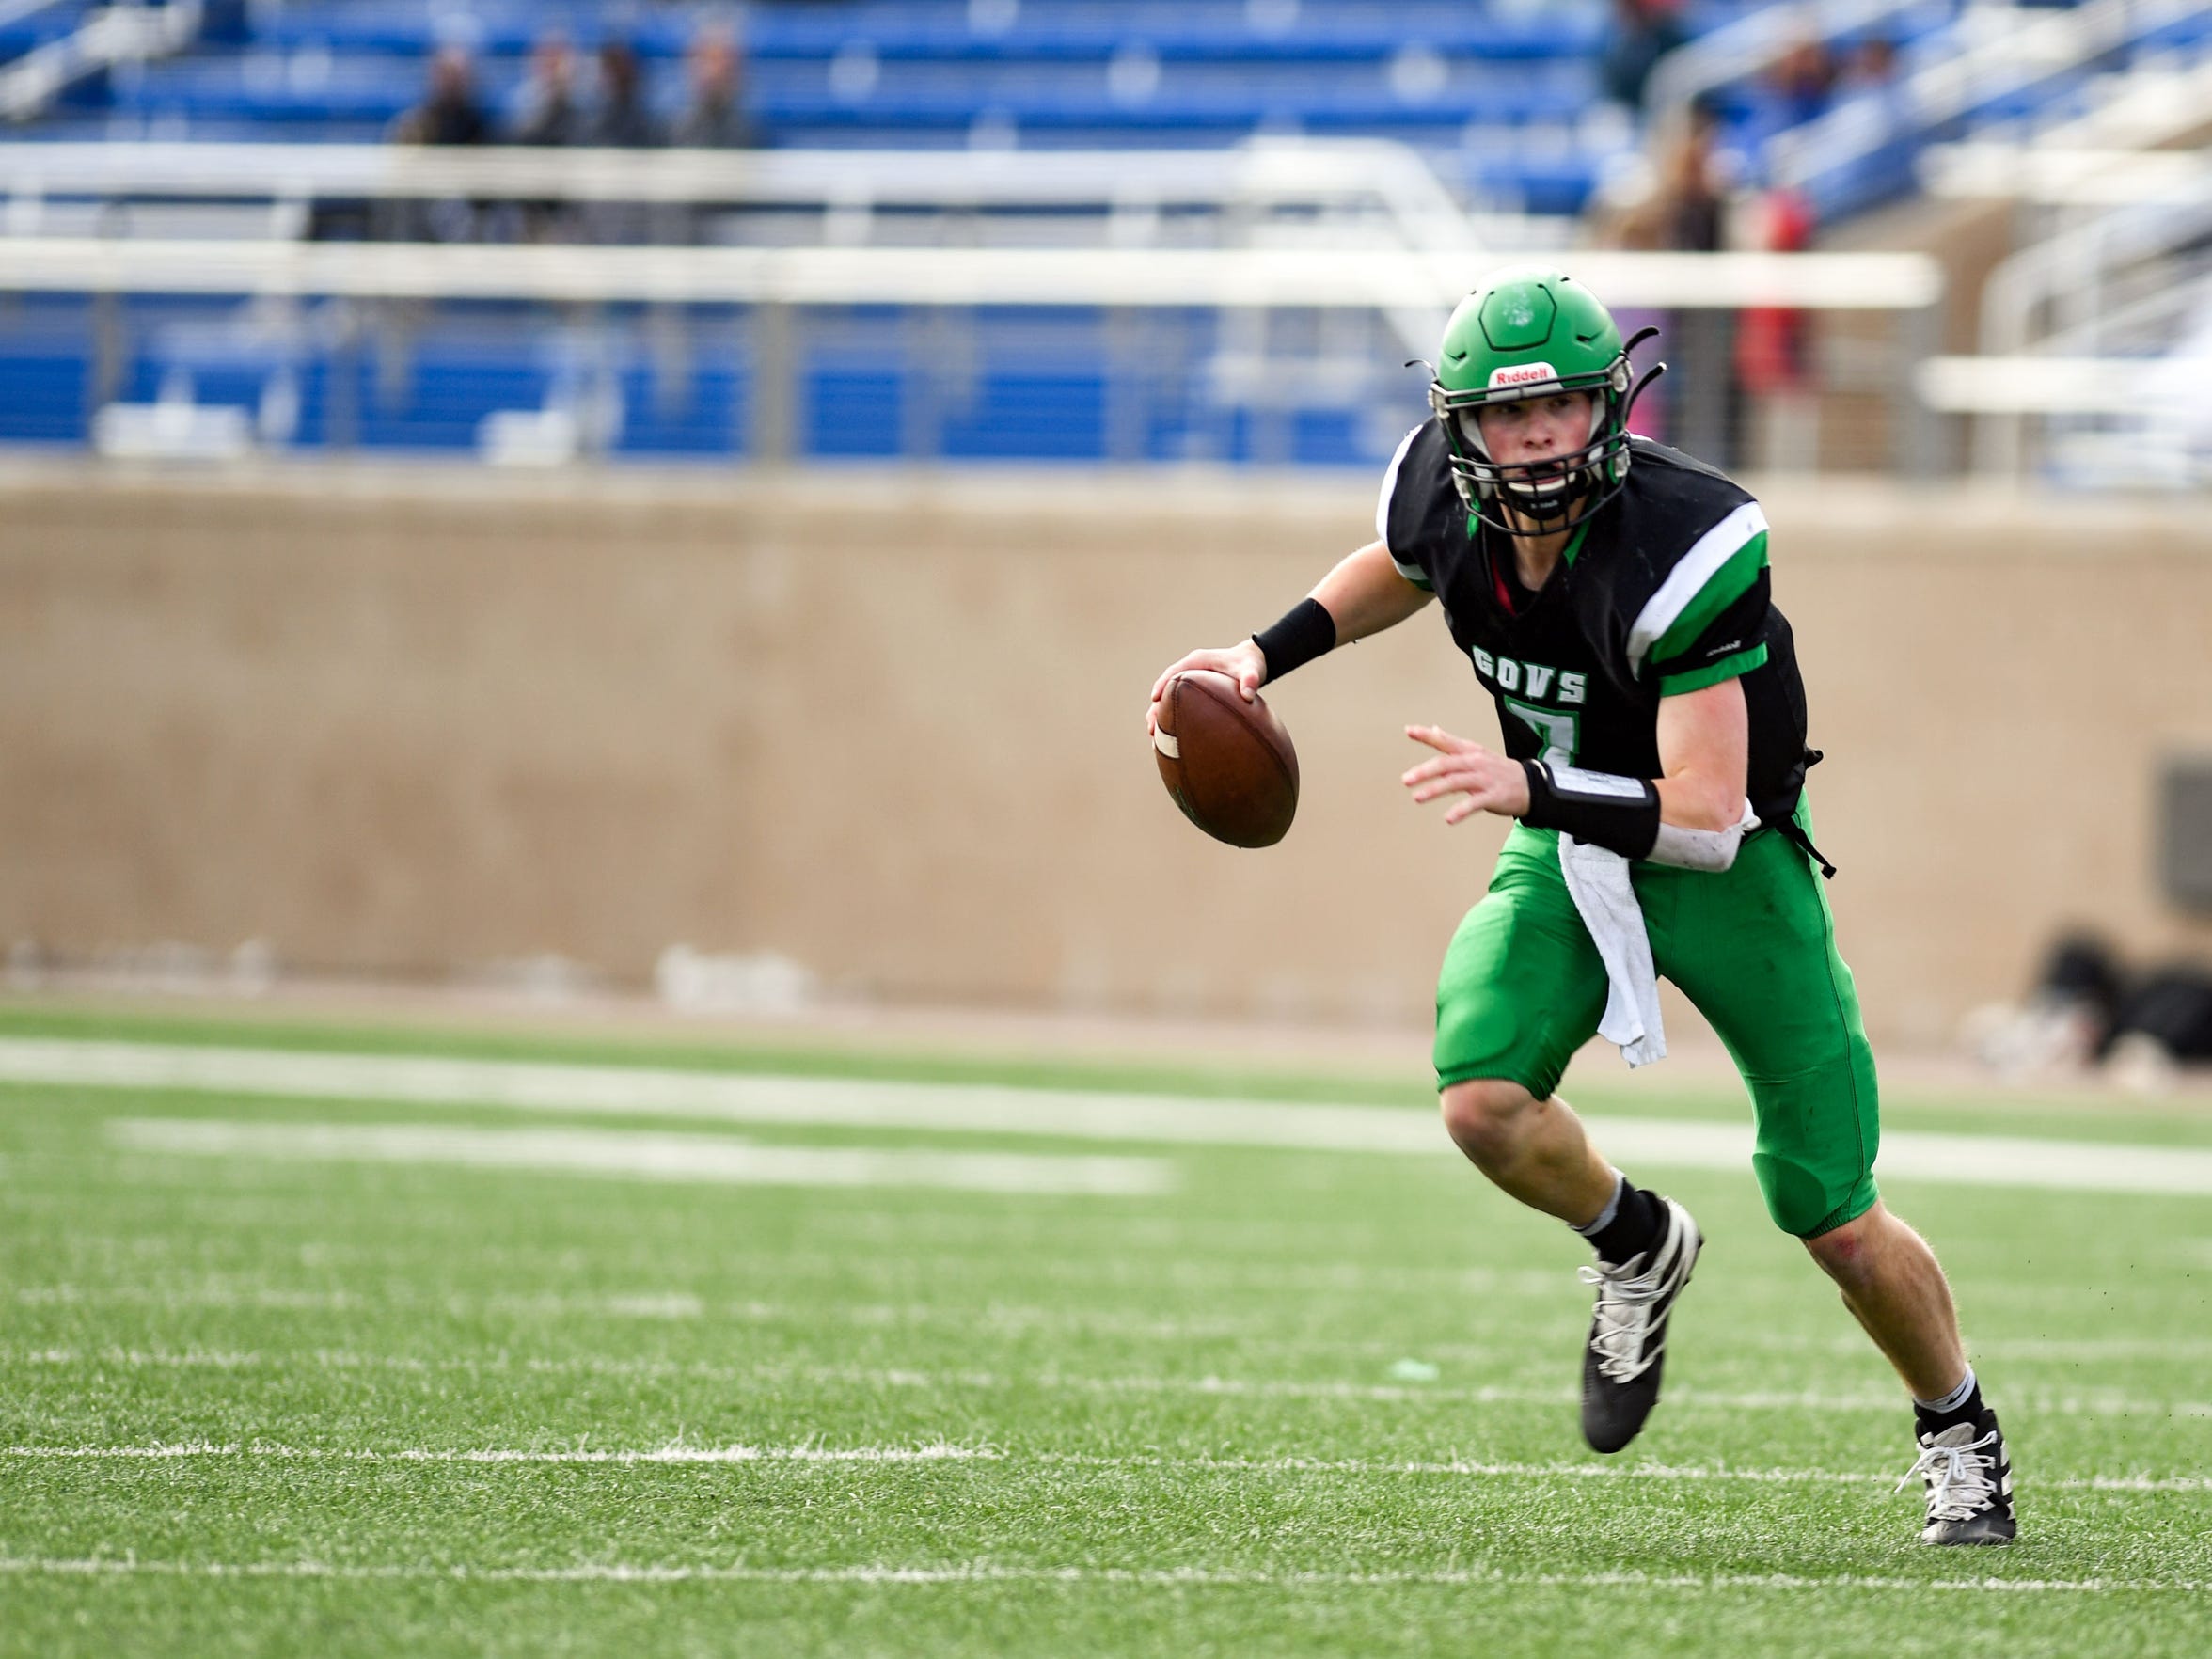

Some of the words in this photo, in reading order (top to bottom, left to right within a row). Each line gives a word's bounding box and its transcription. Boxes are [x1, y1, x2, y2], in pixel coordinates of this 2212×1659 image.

[1496, 368, 1548, 385] Riddell
[1472, 644, 1587, 703] GOVS
[1504, 694, 1580, 767] 7
